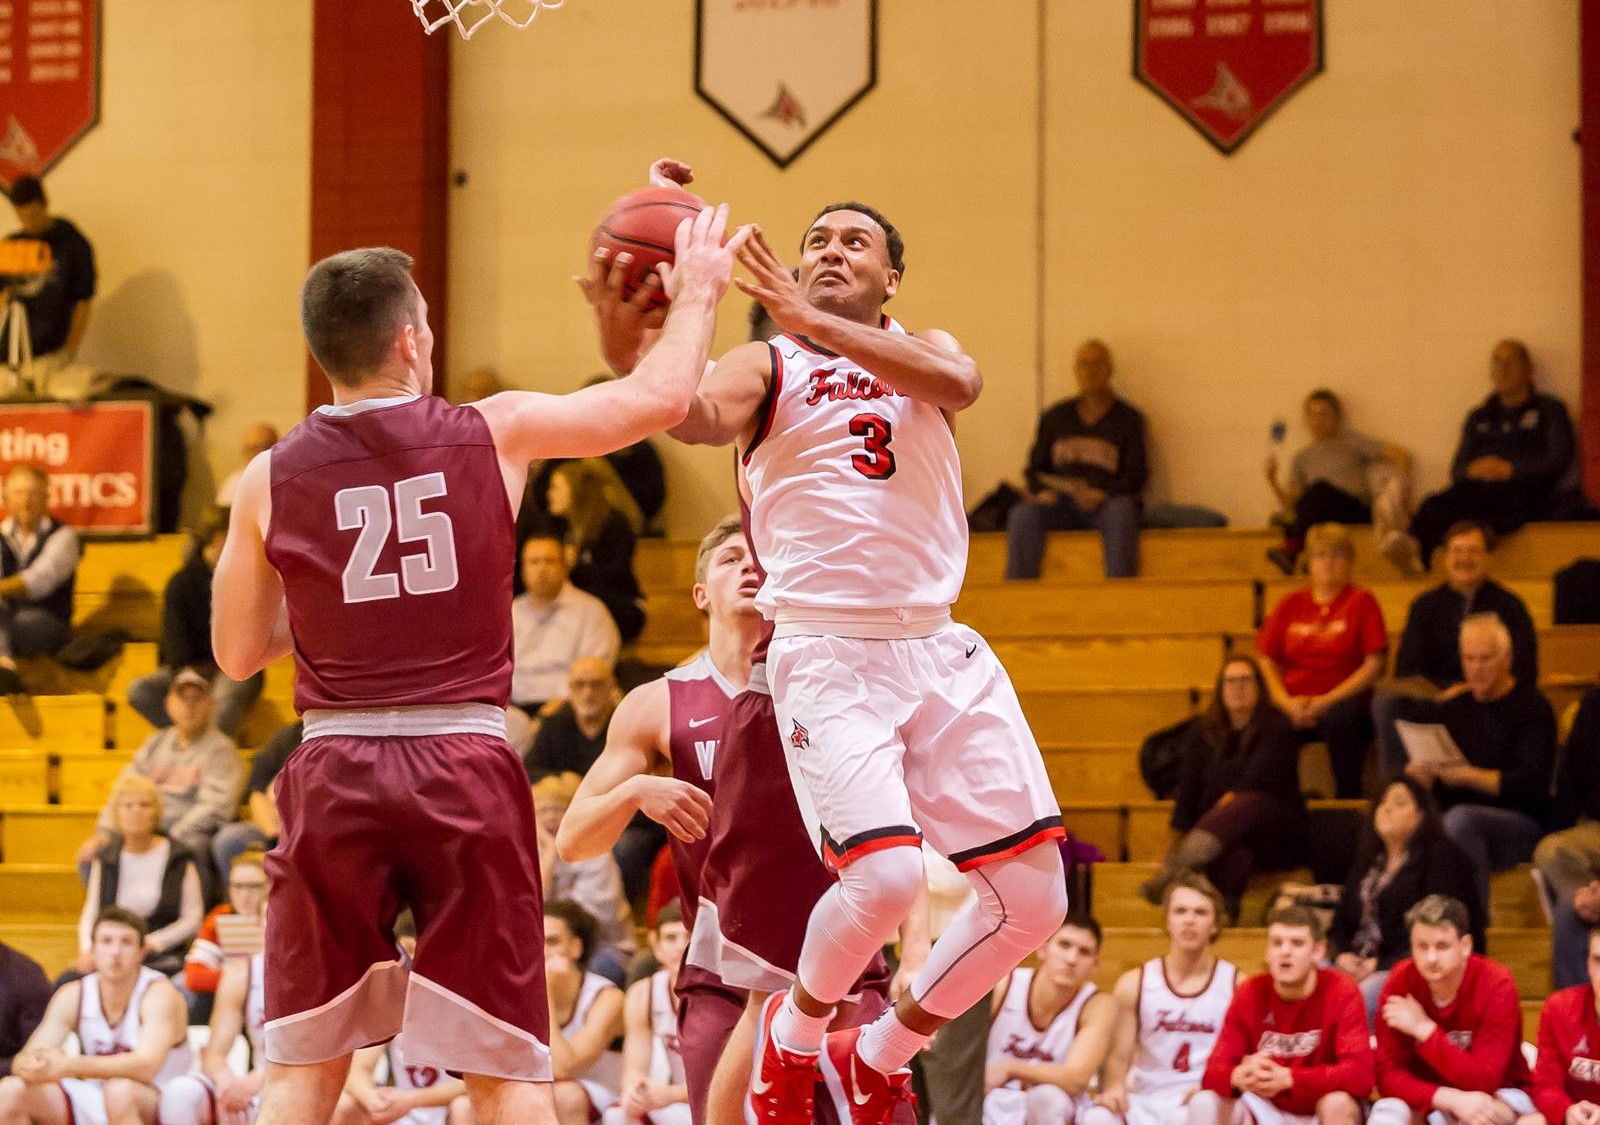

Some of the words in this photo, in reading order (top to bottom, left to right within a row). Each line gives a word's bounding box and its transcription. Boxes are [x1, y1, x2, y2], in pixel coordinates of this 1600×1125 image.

[806, 368, 910, 406] Falco
[848, 412, 897, 480] 3
[334, 471, 460, 604] 25
[694, 739, 721, 781] V
[1172, 1041, 1192, 1072] 4
